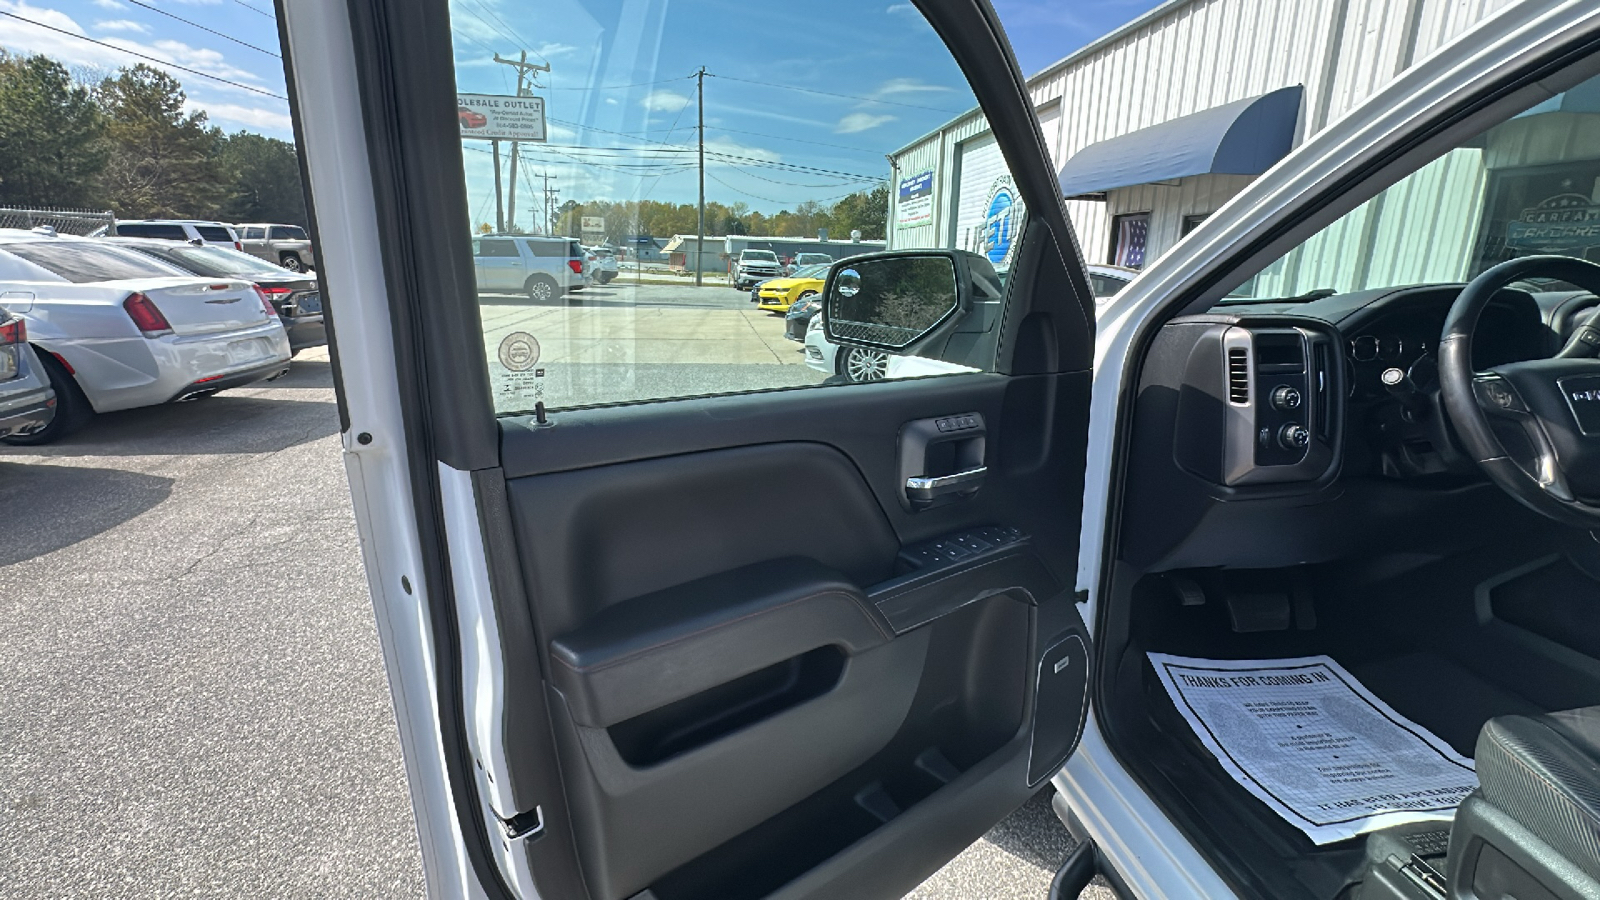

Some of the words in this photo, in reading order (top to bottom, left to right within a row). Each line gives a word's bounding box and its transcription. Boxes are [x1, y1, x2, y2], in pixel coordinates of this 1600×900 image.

[457, 98, 500, 107] OLESALE
[504, 101, 541, 109] OUTLET
[1178, 673, 1232, 688] THANKS
[1230, 676, 1261, 687] FOR
[1259, 673, 1313, 686] COMING
[1310, 671, 1330, 683] IN
[1317, 803, 1333, 811] IT
[1333, 799, 1365, 809] HAS
[1361, 794, 1401, 804] BEEN
